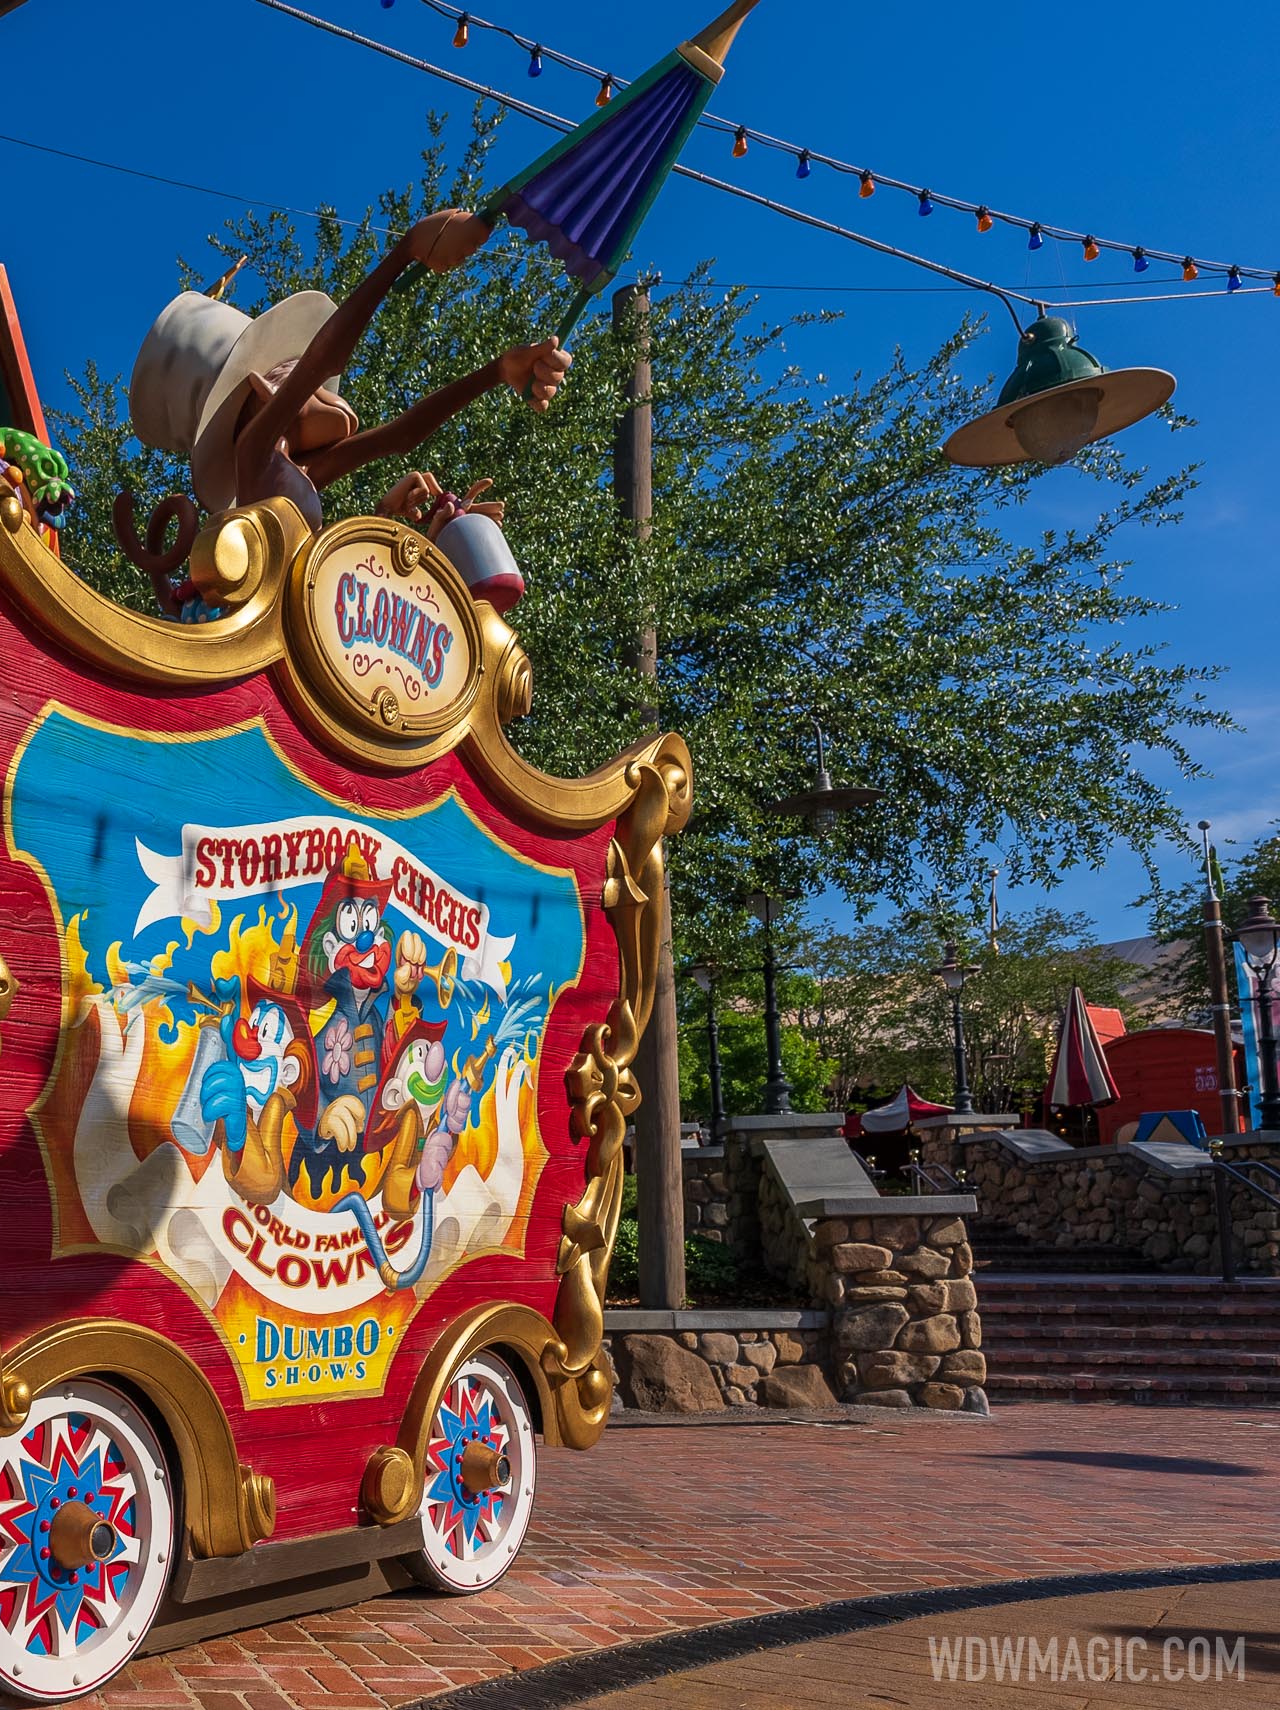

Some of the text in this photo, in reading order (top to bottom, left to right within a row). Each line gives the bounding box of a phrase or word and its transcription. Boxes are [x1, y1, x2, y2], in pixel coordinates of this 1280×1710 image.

[335, 572, 453, 689] CLOWNS
[391, 856, 482, 950] CIRCUS
[240, 1197, 311, 1250] ORLD
[256, 1317, 380, 1362] DUMBO
